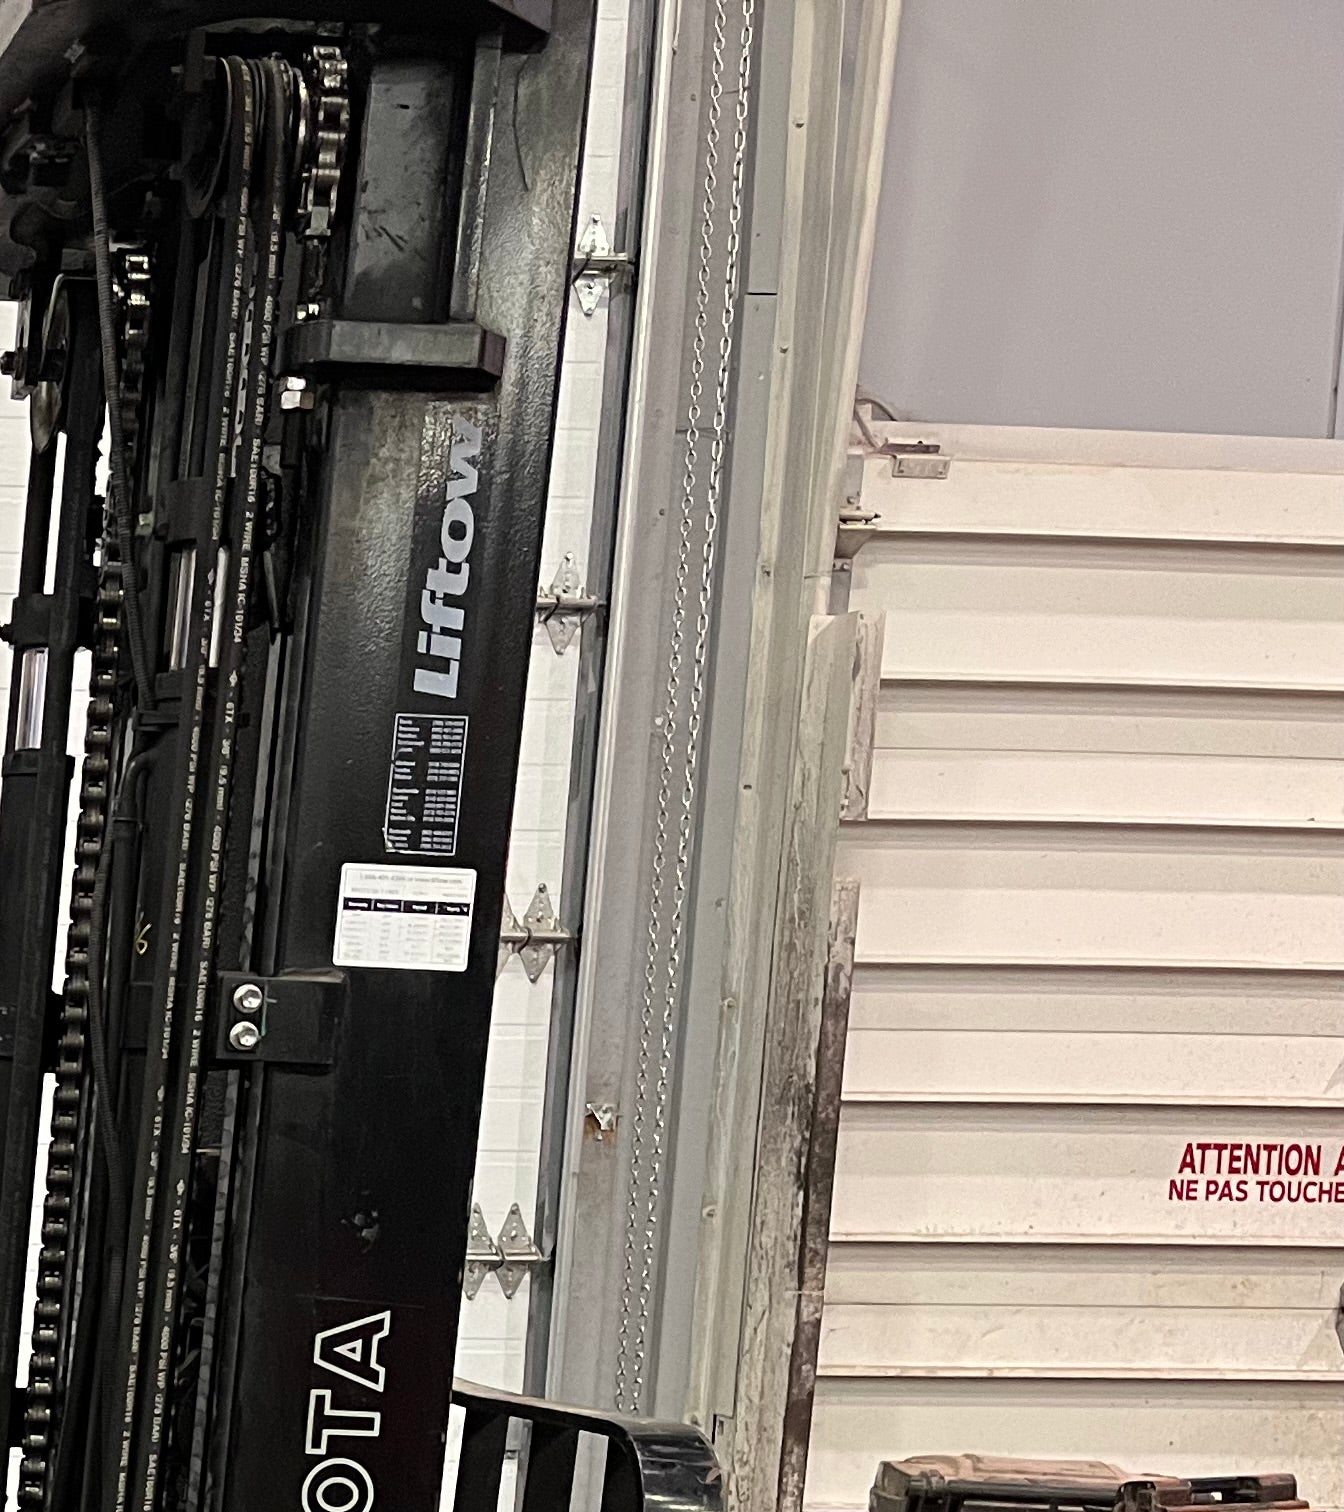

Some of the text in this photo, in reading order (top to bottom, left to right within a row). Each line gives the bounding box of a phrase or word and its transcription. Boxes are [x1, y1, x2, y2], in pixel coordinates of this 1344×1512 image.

[413, 414, 483, 699] Liftow
[1178, 1143, 1322, 1176] ATTENTION
[1168, 1179, 1344, 1203] NE PAS TOUCHE
